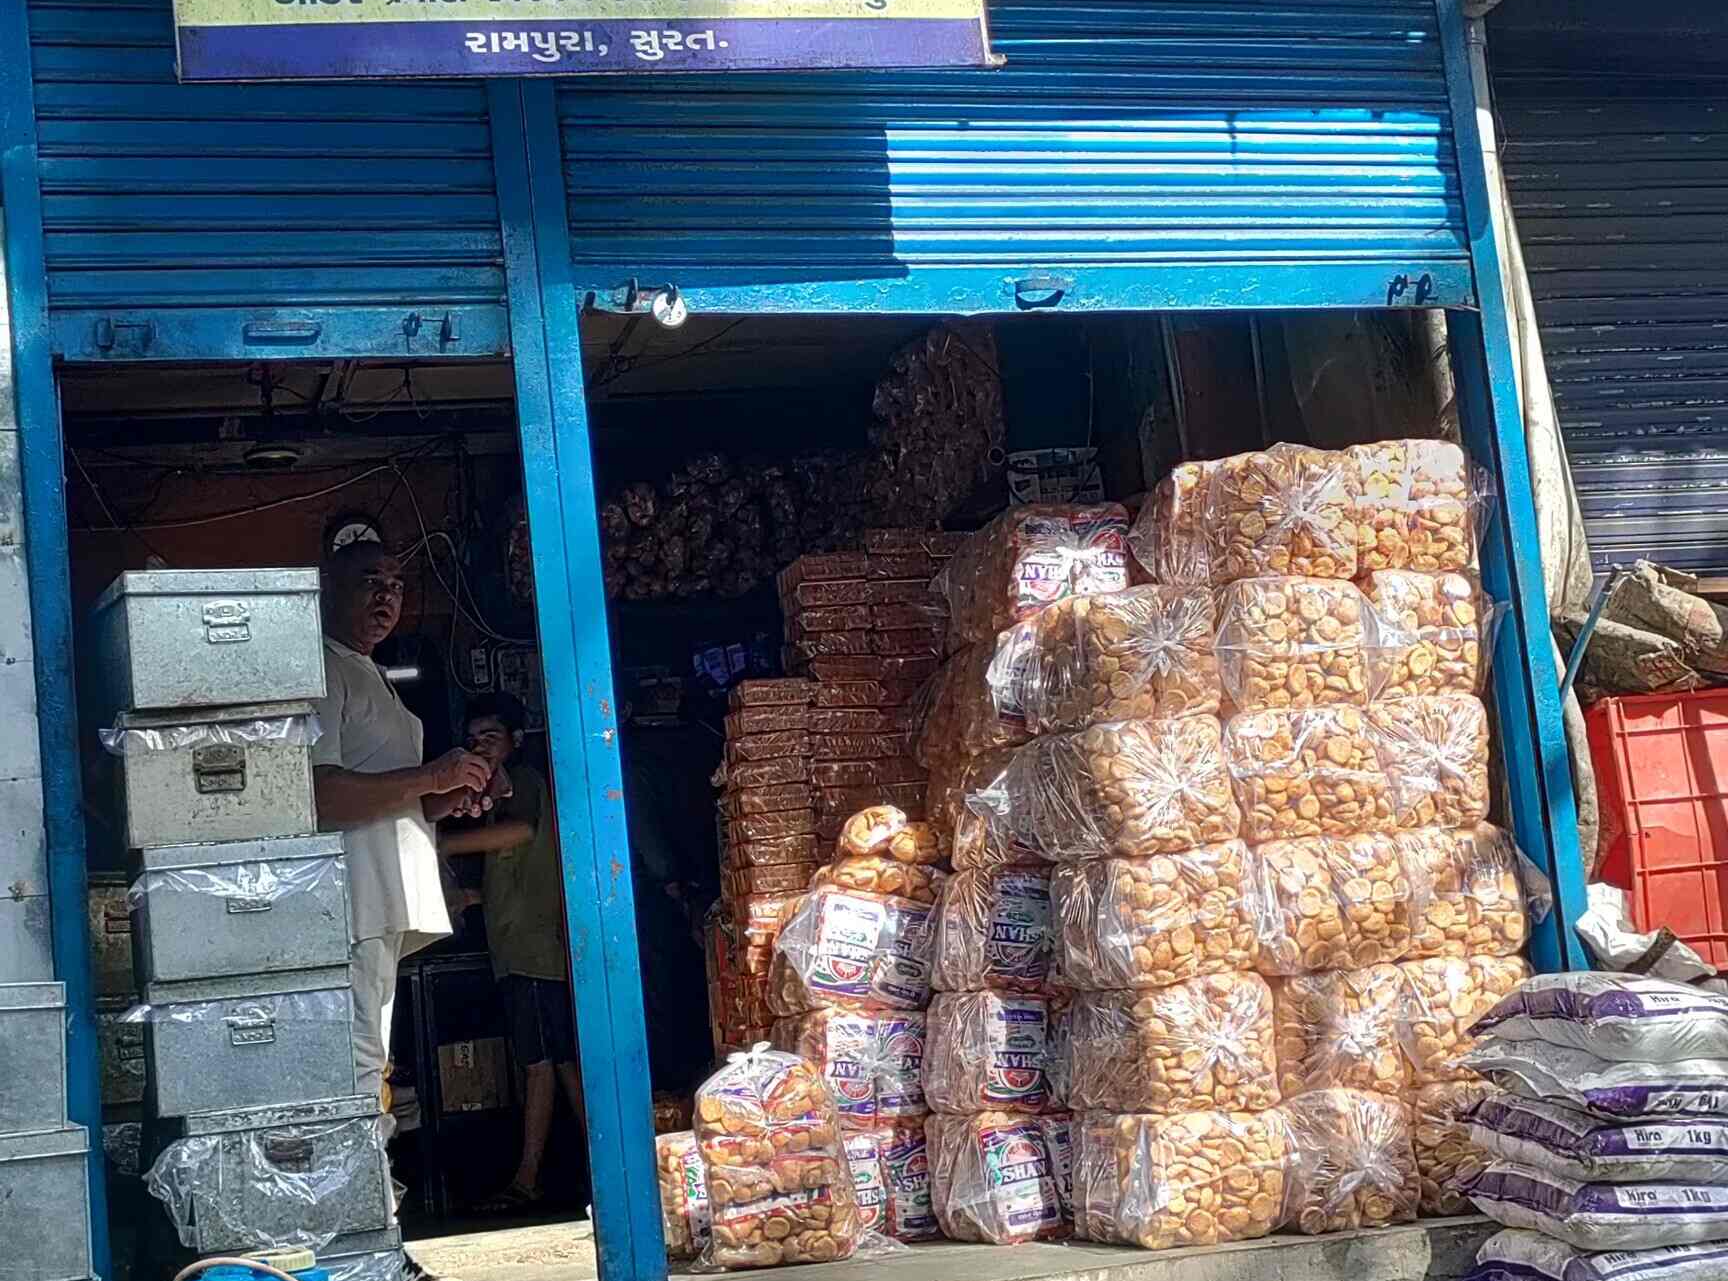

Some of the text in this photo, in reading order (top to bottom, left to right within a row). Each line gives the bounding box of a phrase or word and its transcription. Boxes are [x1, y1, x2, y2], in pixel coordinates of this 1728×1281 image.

[465, 29, 728, 62] રામપુરા, સુરત.
[1688, 1129, 1712, 1145] 1kg
[1003, 1160, 1047, 1181] SHAN
[1682, 1188, 1711, 1202] 1kg
